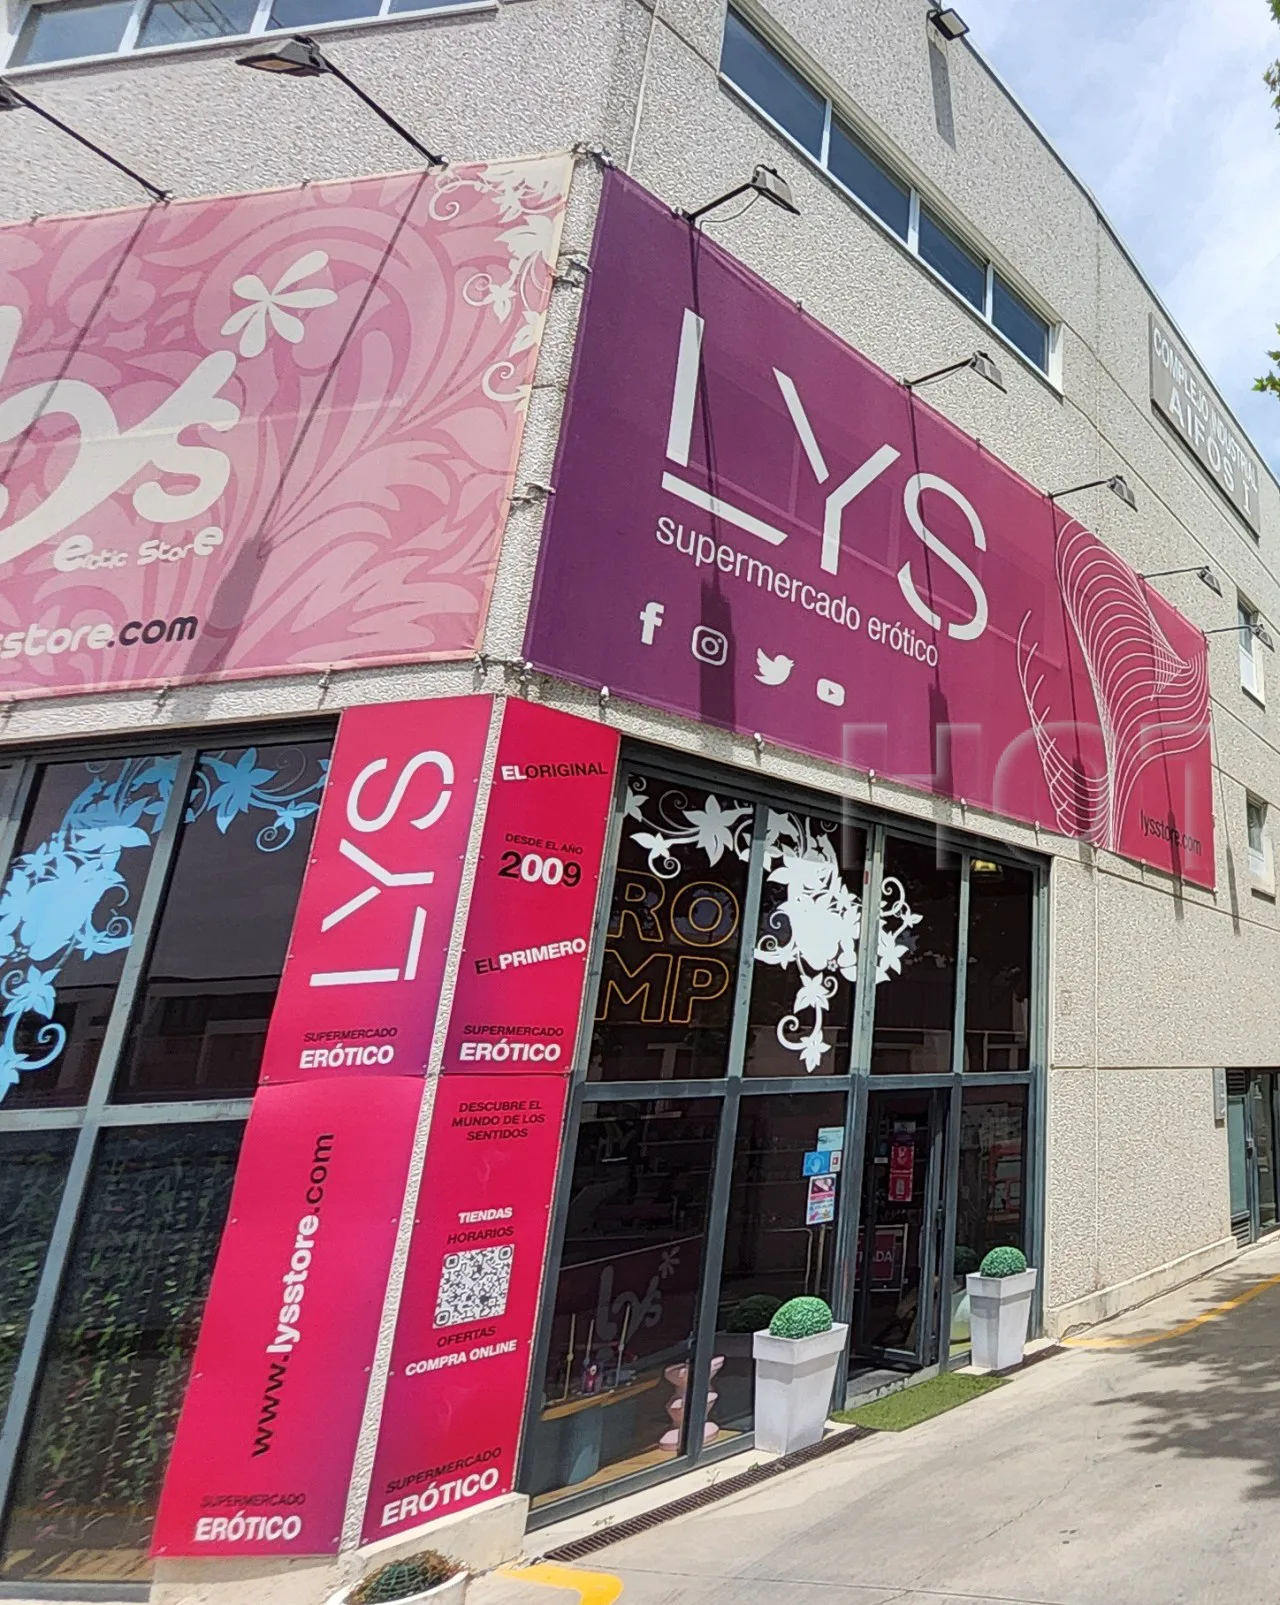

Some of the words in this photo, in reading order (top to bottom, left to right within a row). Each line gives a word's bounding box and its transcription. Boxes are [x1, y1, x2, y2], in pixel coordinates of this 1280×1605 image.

[1169, 386, 1235, 492] AIFOS
[661, 307, 988, 641] LYS
[655, 516, 861, 631] supermercado
[867, 616, 939, 667] erótico
[0, 615, 199, 659] store.com
[505, 833, 543, 848] DESDE
[545, 841, 559, 851] EL
[560, 841, 583, 855] AÑO
[1140, 808, 1202, 857] lysstore.com
[309, 750, 455, 988] LYS
[498, 851, 582, 888] 2009
[303, 1027, 398, 1043] SUPERMERCADO
[463, 1025, 565, 1037] SUPERMERCADO
[299, 1042, 395, 1069] ERÓTICO
[459, 1038, 561, 1062] ERÓTICO
[451, 1115, 500, 1127] MUNDO
[503, 1114, 521, 1125] DE
[522, 1113, 546, 1124] LOS
[459, 1101, 527, 1113] DESCUBRE
[528, 1100, 543, 1110] EL
[466, 1128, 529, 1141] SENTIDOS
[458, 1207, 513, 1224] TIENDAS
[447, 1226, 515, 1245] HORARIOS
[252, 1132, 335, 1459] www.lysstore.com
[436, 1326, 497, 1348] OFERTAS
[405, 1351, 467, 1376] COMPRA
[469, 1339, 518, 1361] ONLINE
[386, 1446, 503, 1494] SUPERMERCADO
[201, 1492, 306, 1508] SUPERMERCADO
[380, 1467, 500, 1528] ERÓTICO
[193, 1510, 303, 1542] ERÓTICO
